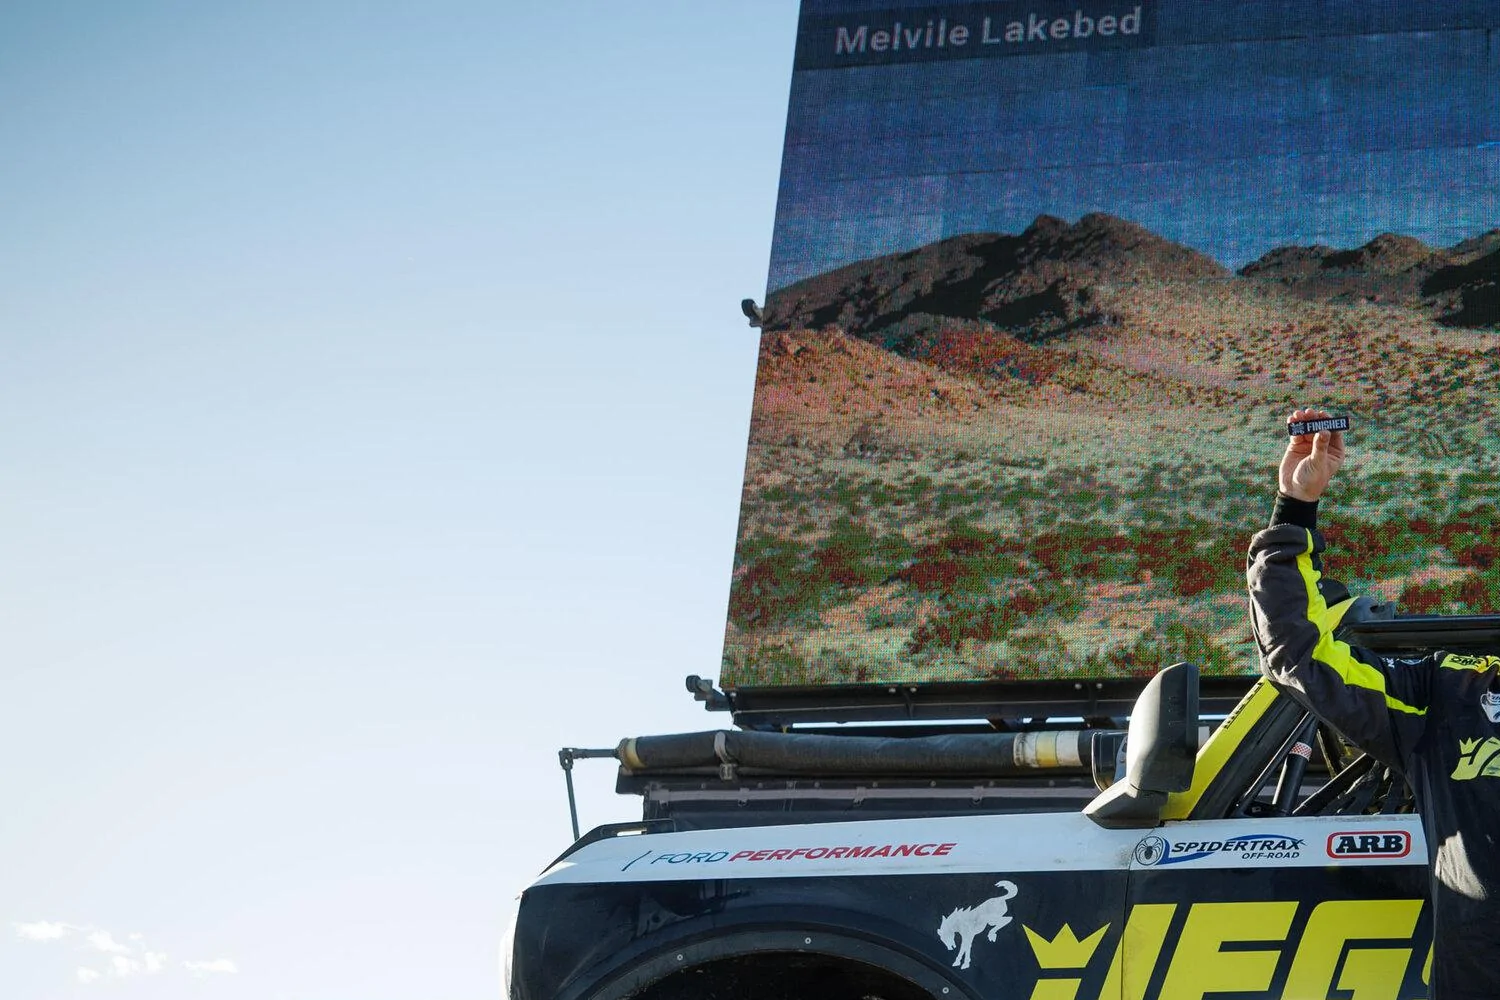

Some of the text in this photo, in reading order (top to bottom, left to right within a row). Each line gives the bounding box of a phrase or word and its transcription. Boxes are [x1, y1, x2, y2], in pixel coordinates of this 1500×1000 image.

[834, 5, 1142, 55] Melvile Lakebed
[1306, 418, 1347, 432] FINISHER
[1171, 838, 1307, 854] SPIDERTRAX
[1334, 834, 1404, 854] ARB
[650, 842, 958, 865] FORD PERFORMANCE
[1241, 851, 1301, 860] OFF-ROAD
